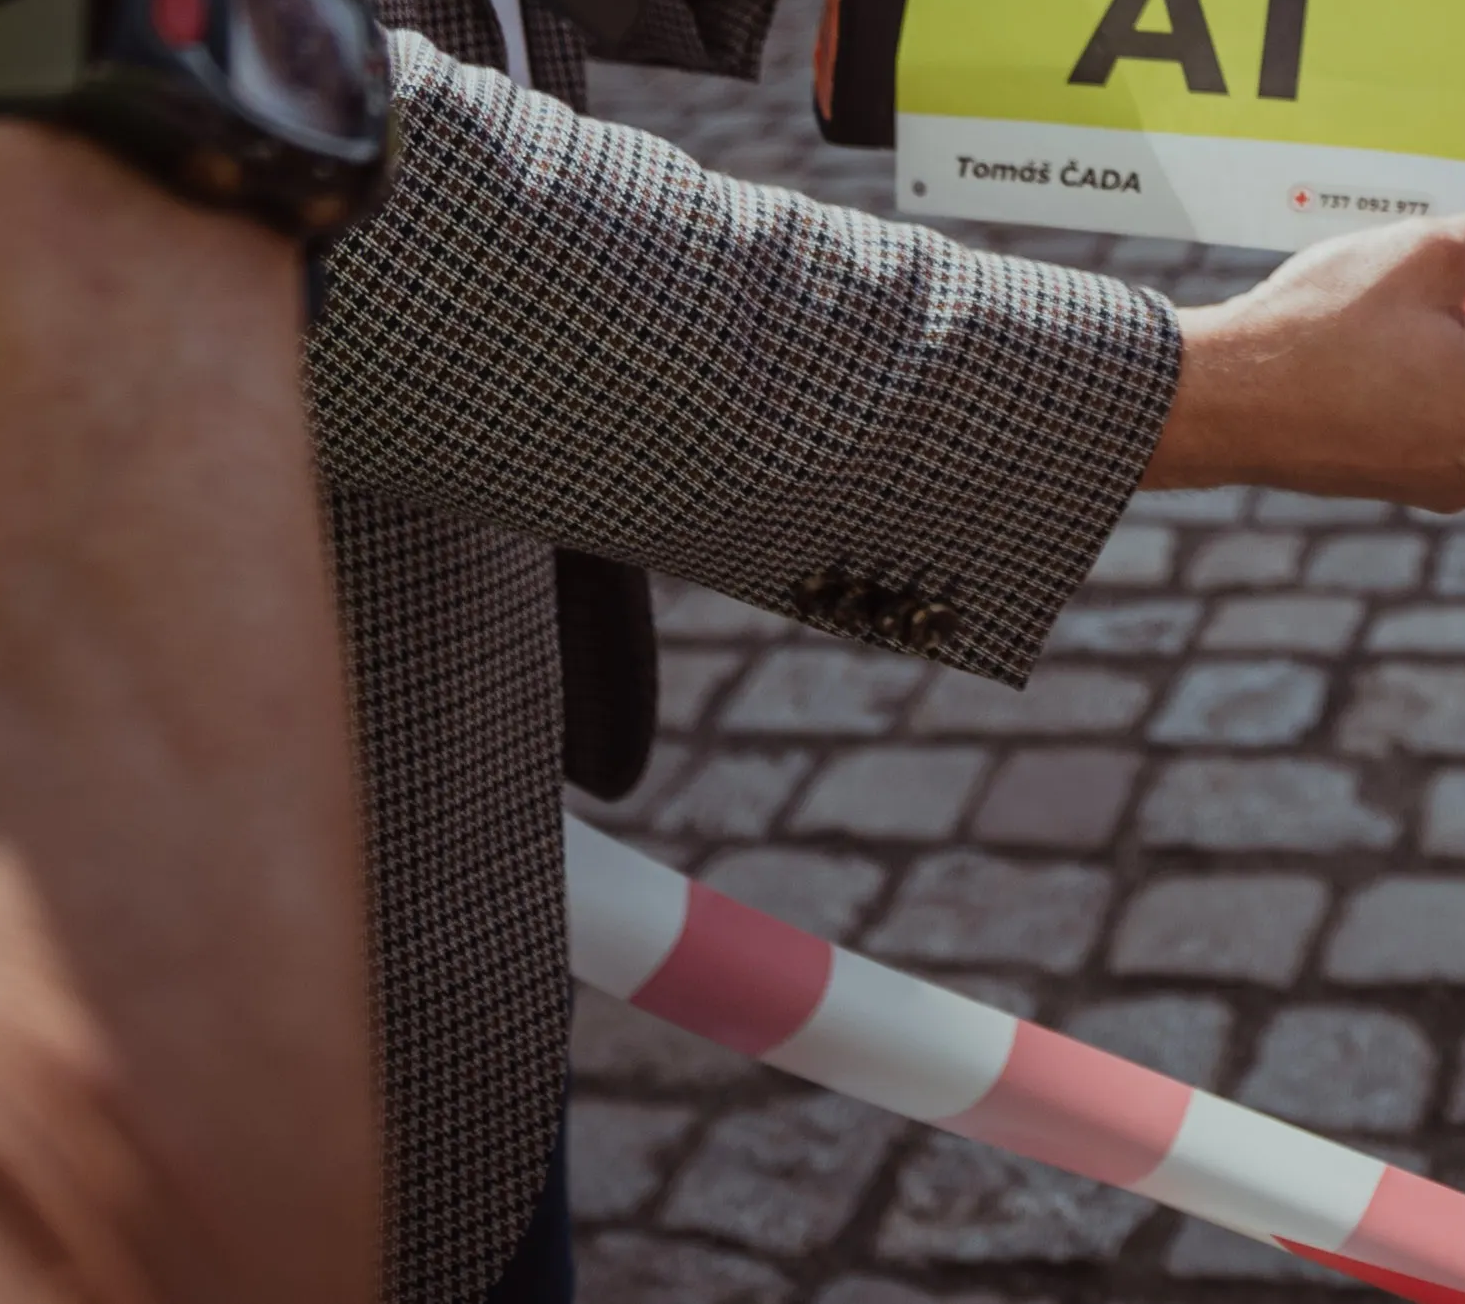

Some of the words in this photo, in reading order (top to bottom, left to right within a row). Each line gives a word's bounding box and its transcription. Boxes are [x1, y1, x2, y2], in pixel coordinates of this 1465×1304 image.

[956, 155, 1052, 185] Tomáš
[1060, 159, 1142, 194] ČADA
[1319, 193, 1351, 209] 737
[1356, 196, 1391, 213] 092
[1395, 200, 1430, 216] 977
